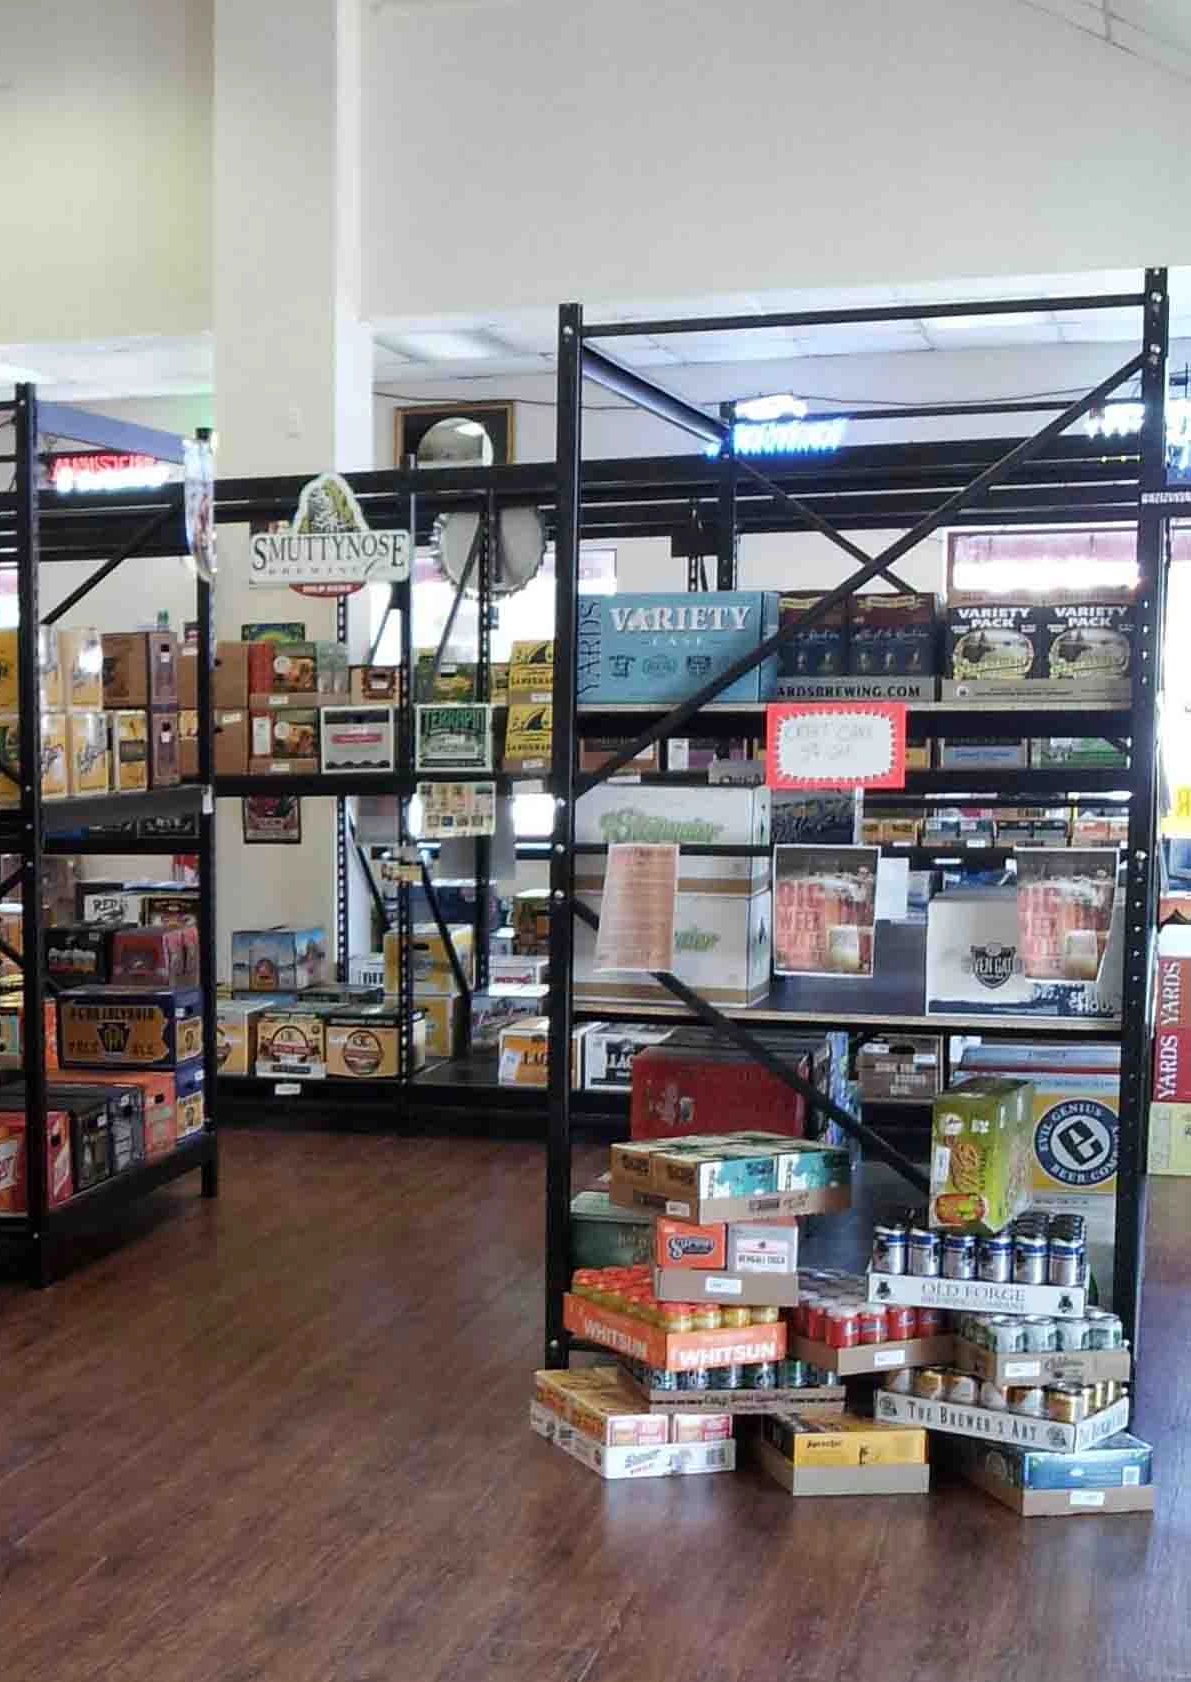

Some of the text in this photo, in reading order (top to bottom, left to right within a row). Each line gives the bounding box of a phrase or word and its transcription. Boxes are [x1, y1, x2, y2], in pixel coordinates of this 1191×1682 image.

[251, 533, 406, 571] SMUTTYNOSE
[609, 606, 752, 632] VARIETY
[958, 606, 1031, 619] VARIETY
[971, 617, 1015, 628] PACK
[1054, 605, 1128, 618] VARIETY
[1068, 616, 1112, 627] PACK
[777, 684, 921, 699] ARDSBREWING.COM
[1160, 961, 1182, 1026] YARDS
[1158, 1035, 1179, 1099] YARDS
[1038, 1102, 1105, 1153] EVIL GENIUS
[921, 1282, 1026, 1302] OLD FORGE
[675, 1341, 777, 1367] WHITSUN
